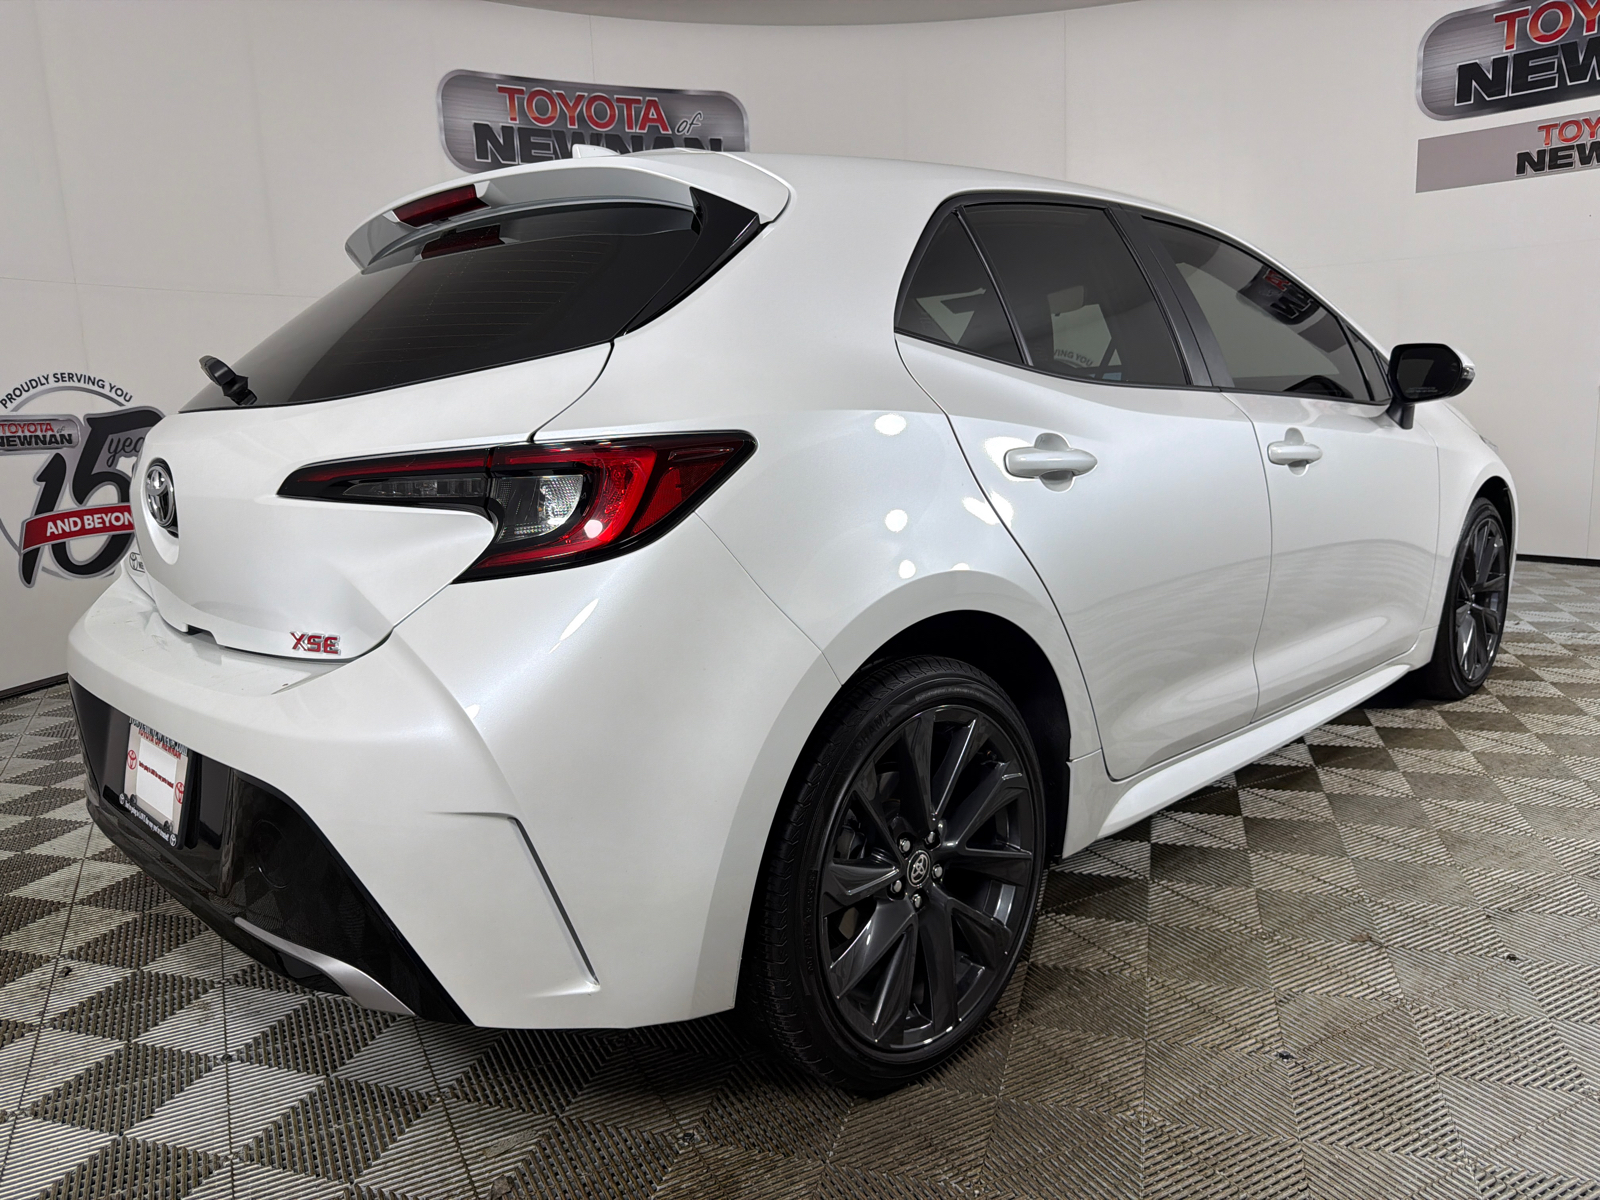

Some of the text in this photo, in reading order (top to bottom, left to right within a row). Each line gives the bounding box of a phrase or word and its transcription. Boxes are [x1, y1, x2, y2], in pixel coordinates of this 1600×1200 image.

[496, 84, 703, 135] TOYOTA of
[1075, 353, 1093, 366] YOU
[0, 372, 133, 409] PROUDLY SERVING YOU
[0, 422, 55, 434] TOYOTA
[46, 517, 82, 536] AND
[290, 631, 341, 655] XSE
